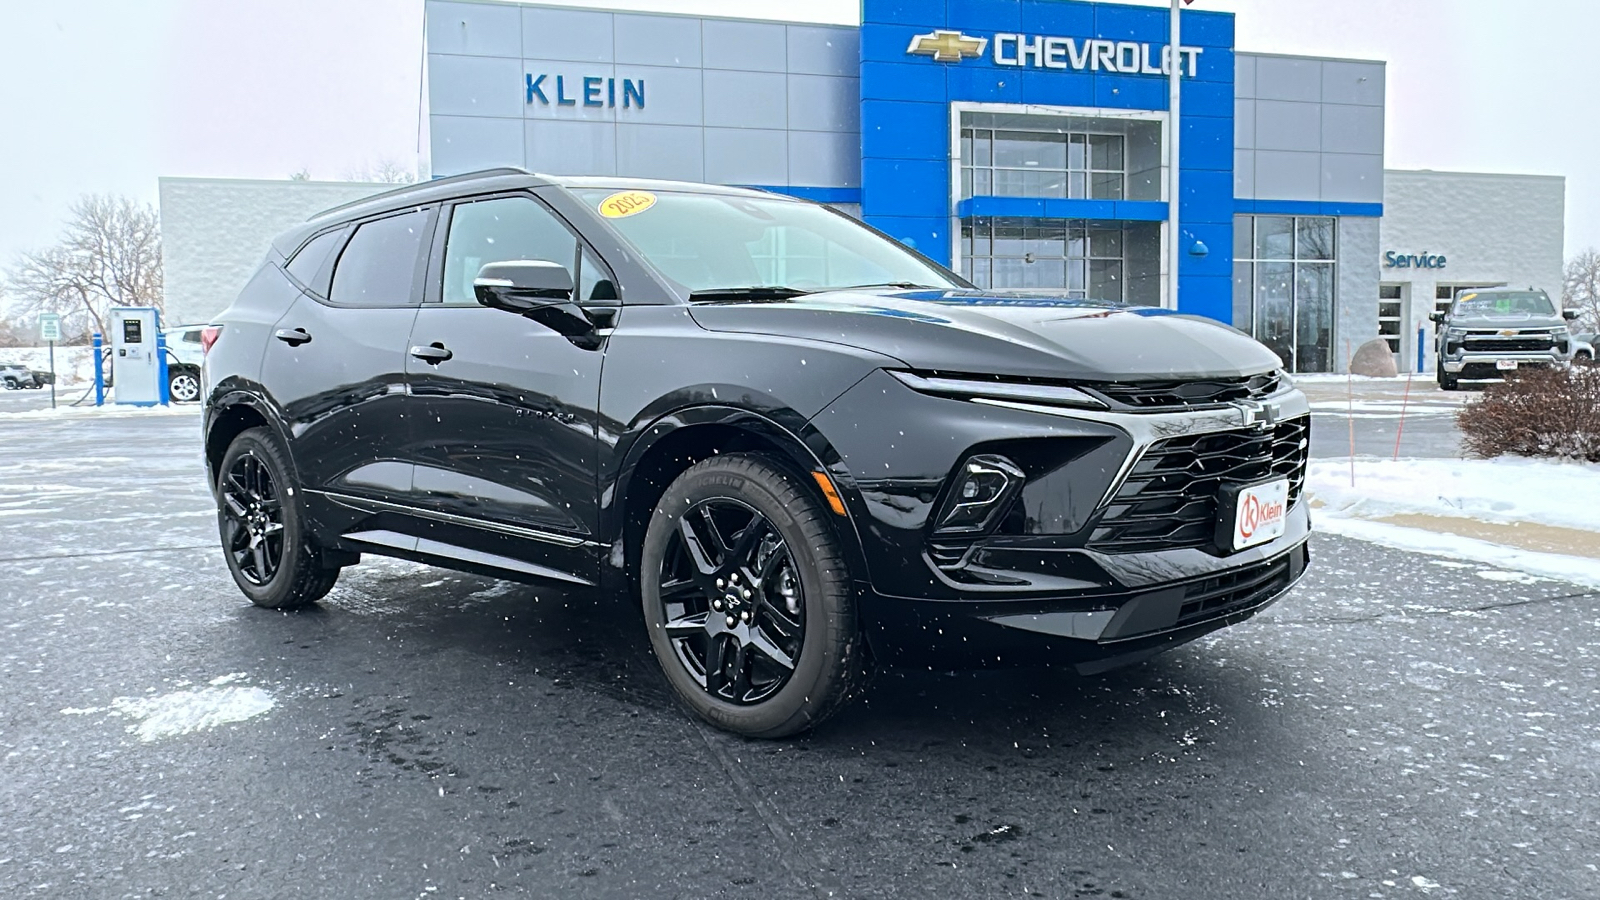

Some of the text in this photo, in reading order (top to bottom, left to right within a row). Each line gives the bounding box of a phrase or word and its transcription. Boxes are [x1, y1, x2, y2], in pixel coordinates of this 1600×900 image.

[526, 73, 645, 109] KLEIN
[609, 192, 650, 215] 2025
[1385, 251, 1447, 269] Service
[1260, 500, 1283, 522] Klein
